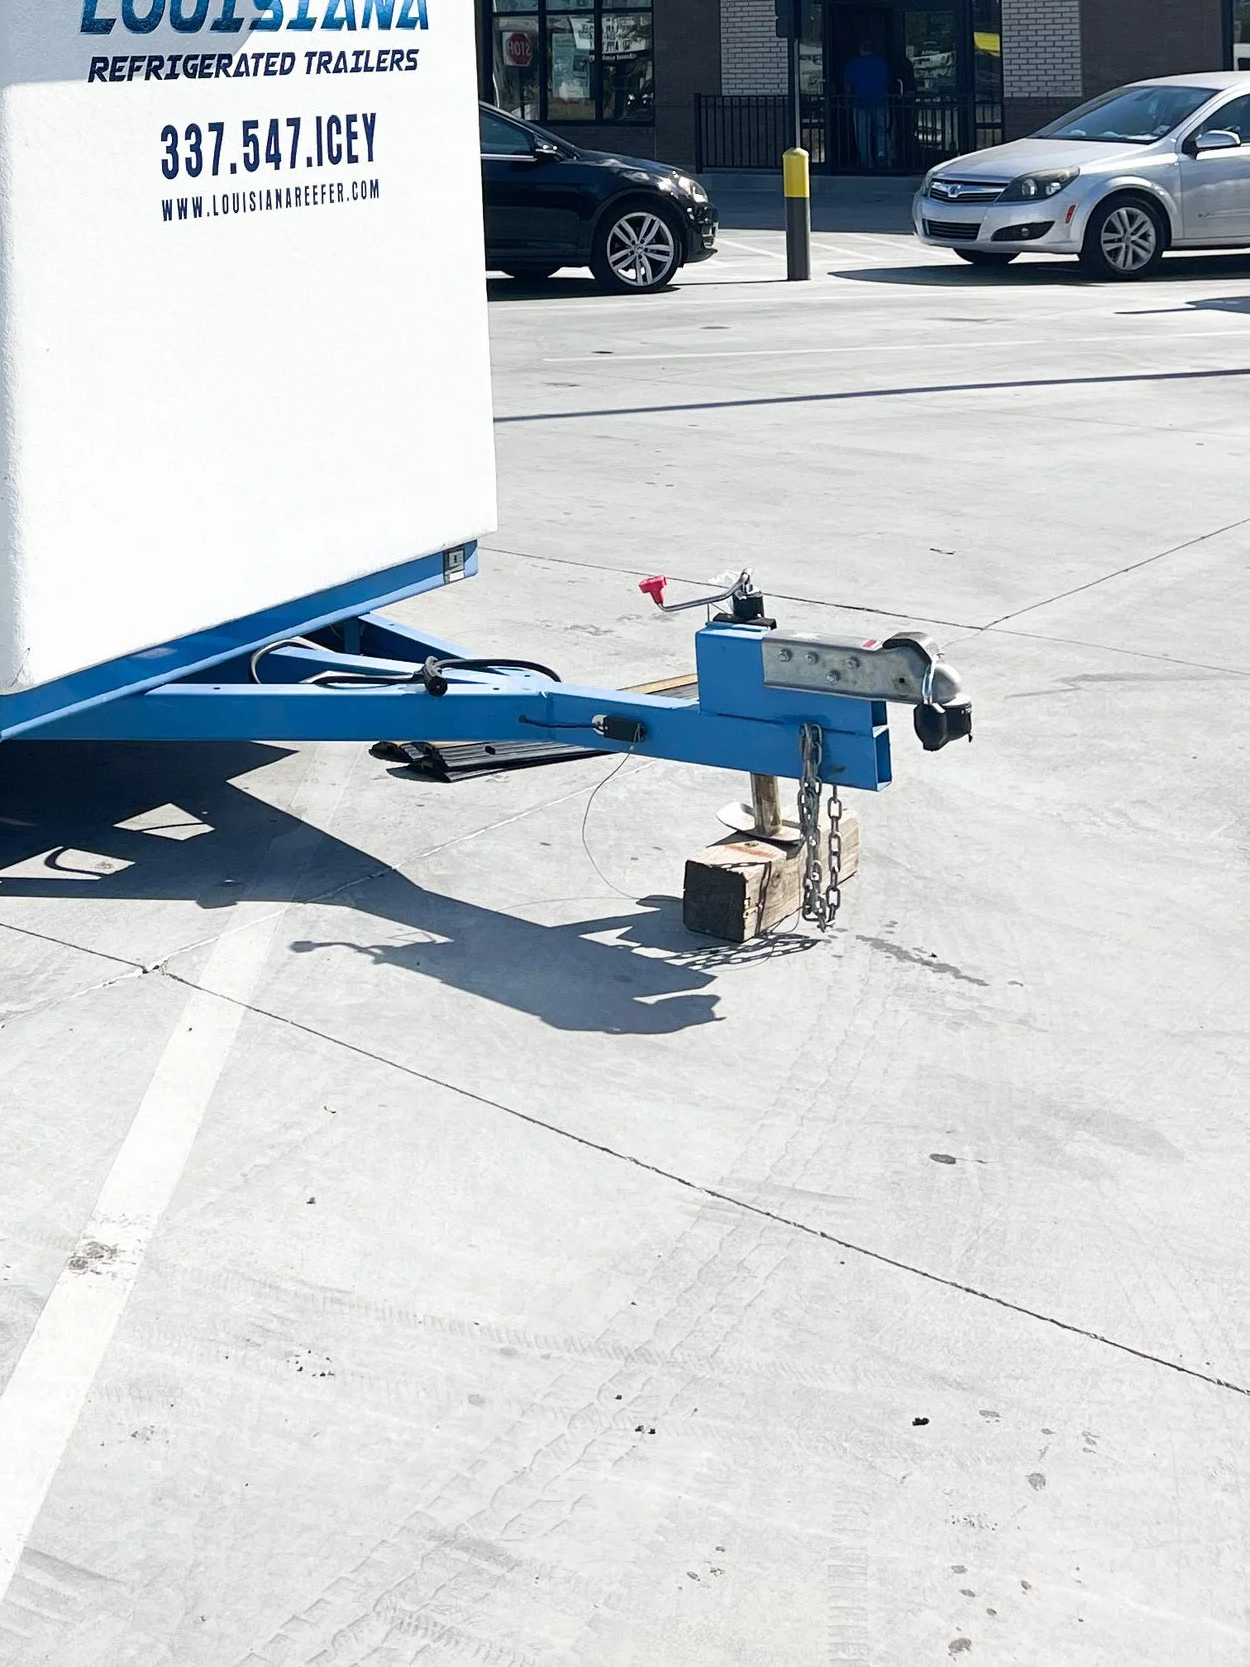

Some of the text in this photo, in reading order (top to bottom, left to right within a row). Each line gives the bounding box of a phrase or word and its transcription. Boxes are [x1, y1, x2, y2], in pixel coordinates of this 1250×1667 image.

[87, 48, 420, 83] REFRIGERATED TRAILERS
[160, 112, 377, 180] 337.547.ICEY
[161, 178, 380, 222] WWW.LOUISIANAREEFER.COM
